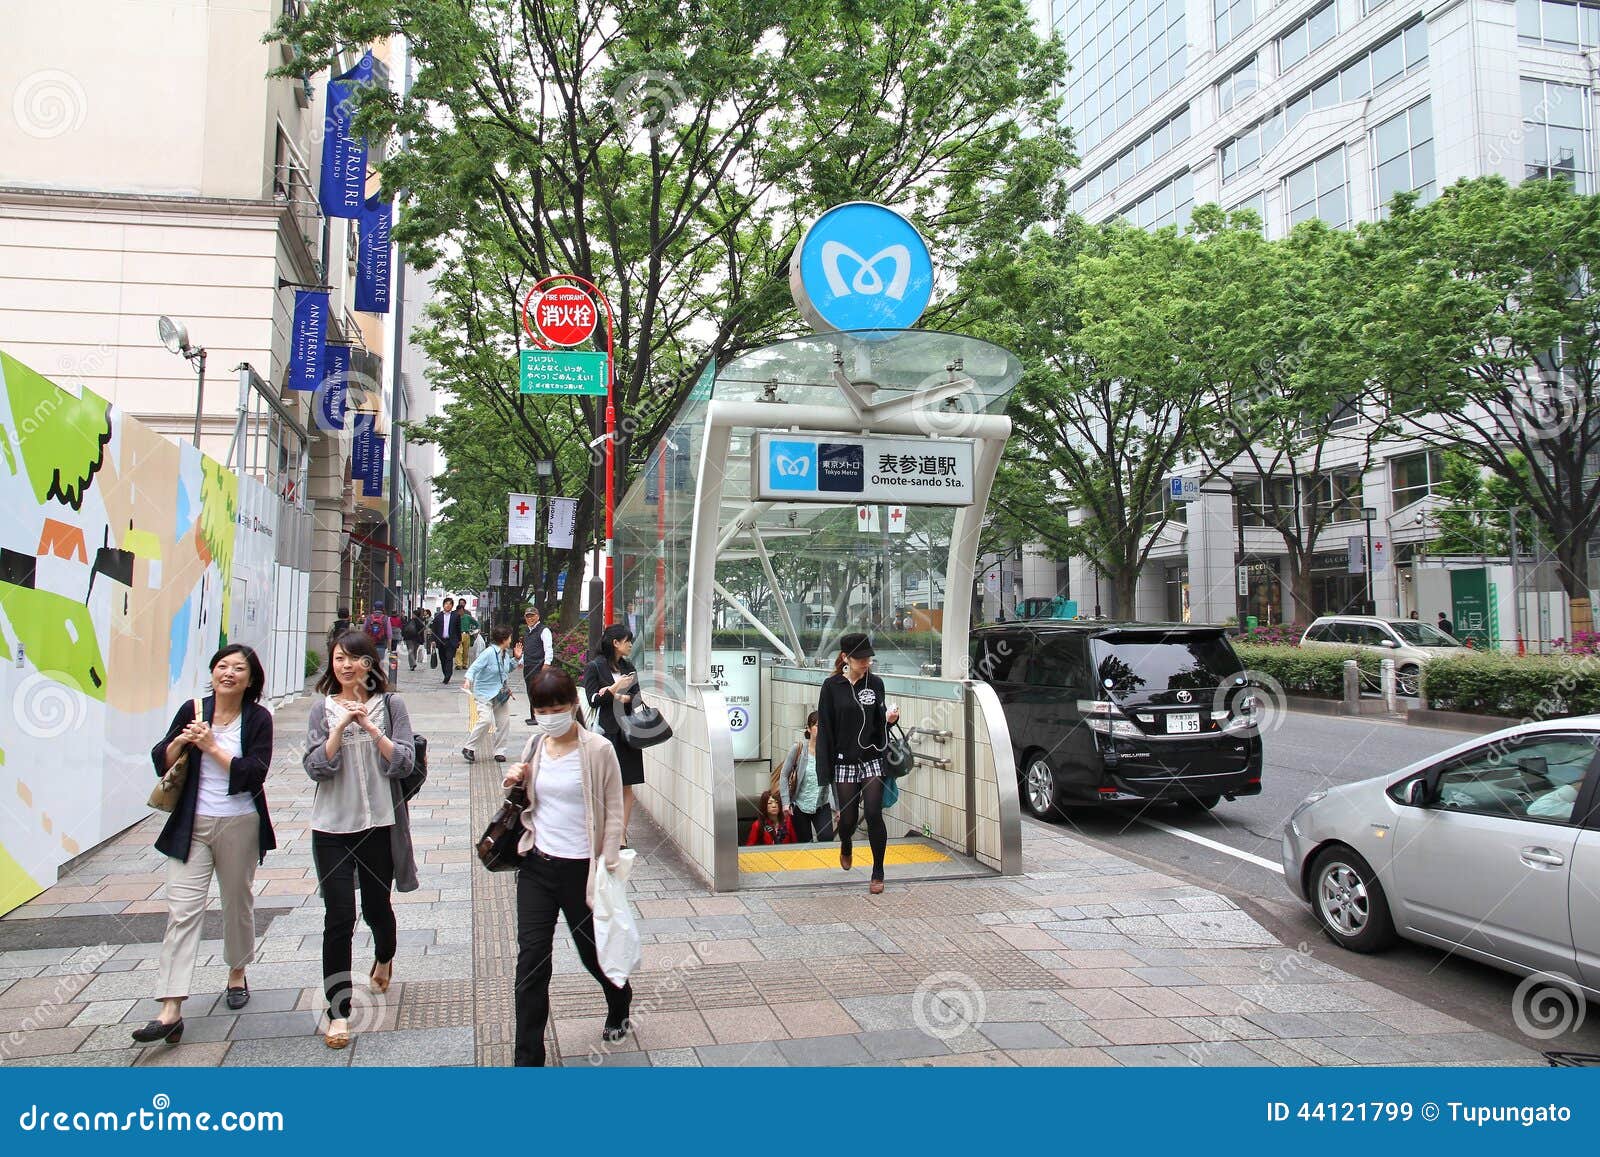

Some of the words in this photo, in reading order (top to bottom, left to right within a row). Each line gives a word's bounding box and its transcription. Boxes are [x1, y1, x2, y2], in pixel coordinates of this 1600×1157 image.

[373, 214, 389, 303] ANNIVERSAIRE
[541, 304, 592, 327] 消火栓
[304, 304, 320, 379] ANNIVERSAIRE
[330, 356, 343, 420] ANNIVERSAIRE
[822, 460, 860, 469] 東京メトロ
[878, 453, 957, 476] 表参道駅
[871, 475, 942, 487] Omote-sando
[945, 477, 965, 488] Sta.
[1174, 480, 1180, 489] P
[743, 656, 756, 665] A2
[710, 665, 724, 679] 駅
[730, 719, 743, 727] 02
